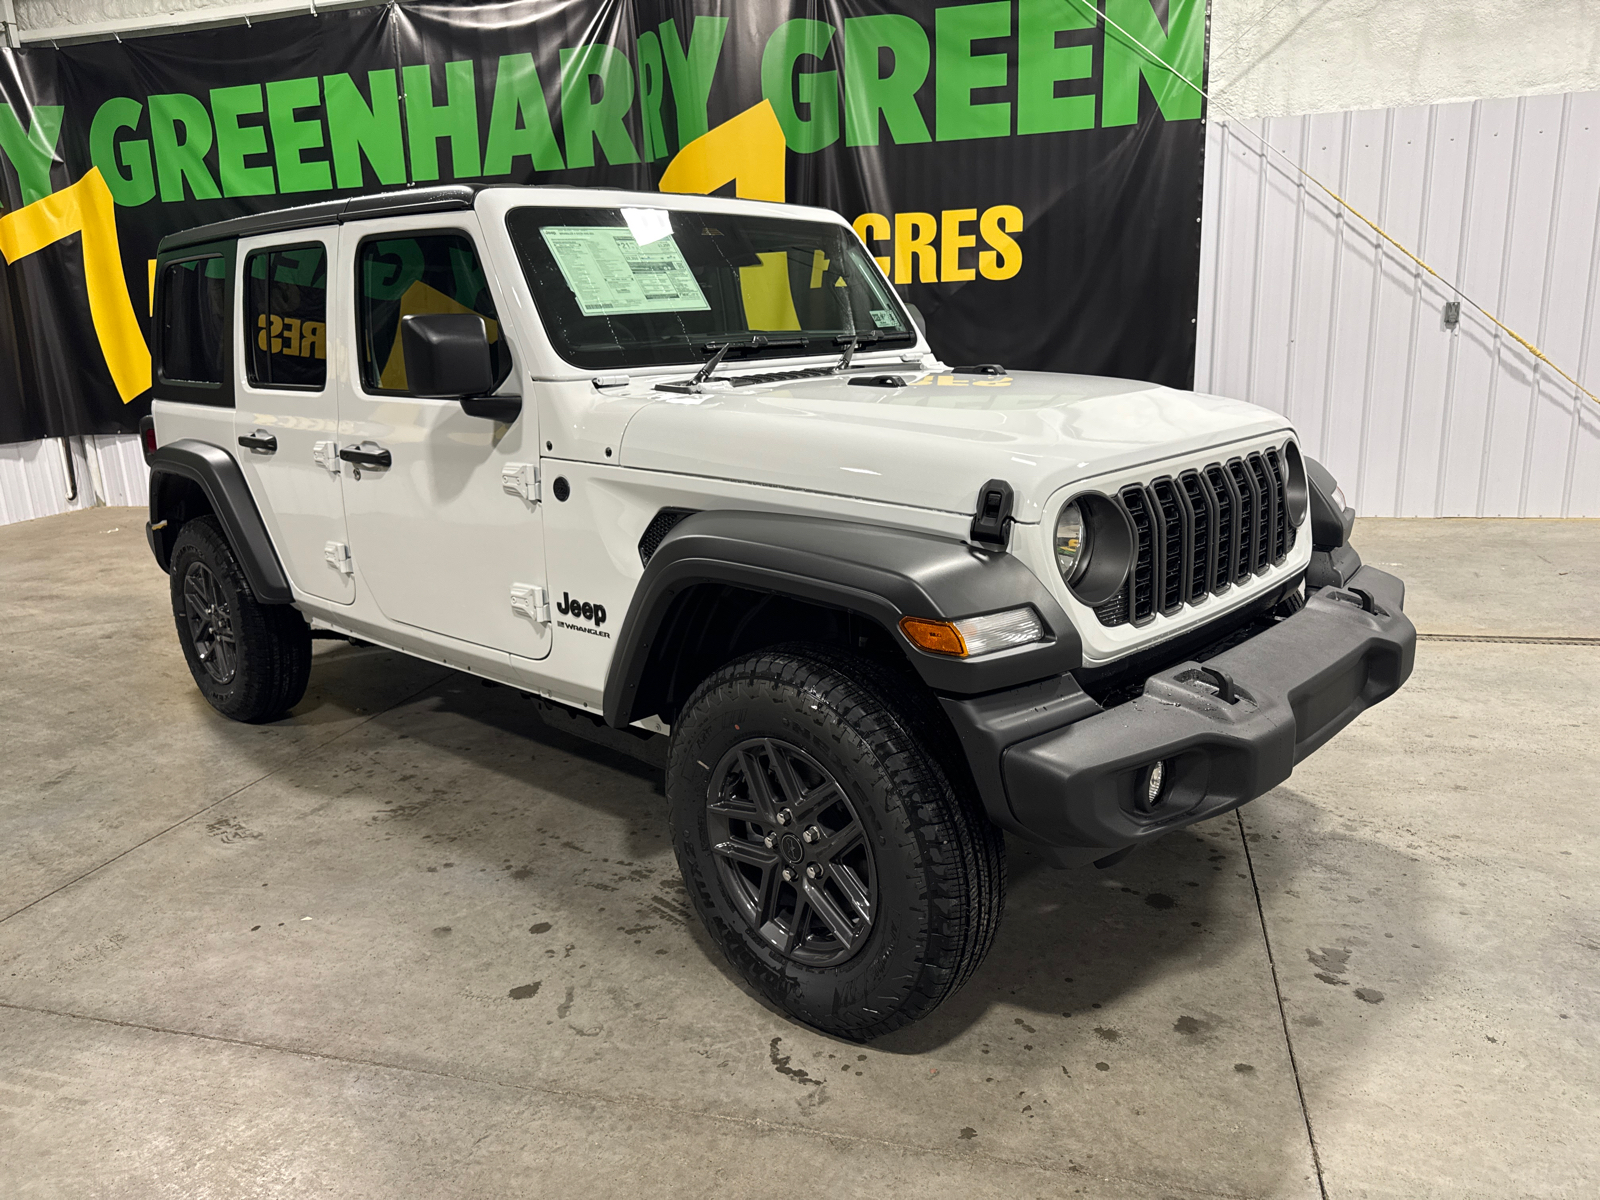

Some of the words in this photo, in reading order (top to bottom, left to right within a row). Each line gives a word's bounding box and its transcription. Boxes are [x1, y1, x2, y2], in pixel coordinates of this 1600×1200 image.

[761, 0, 1206, 154] GREEN
[88, 68, 401, 207] GREEN
[556, 591, 607, 627] Jeep
[564, 622, 611, 639] WRANGLER
